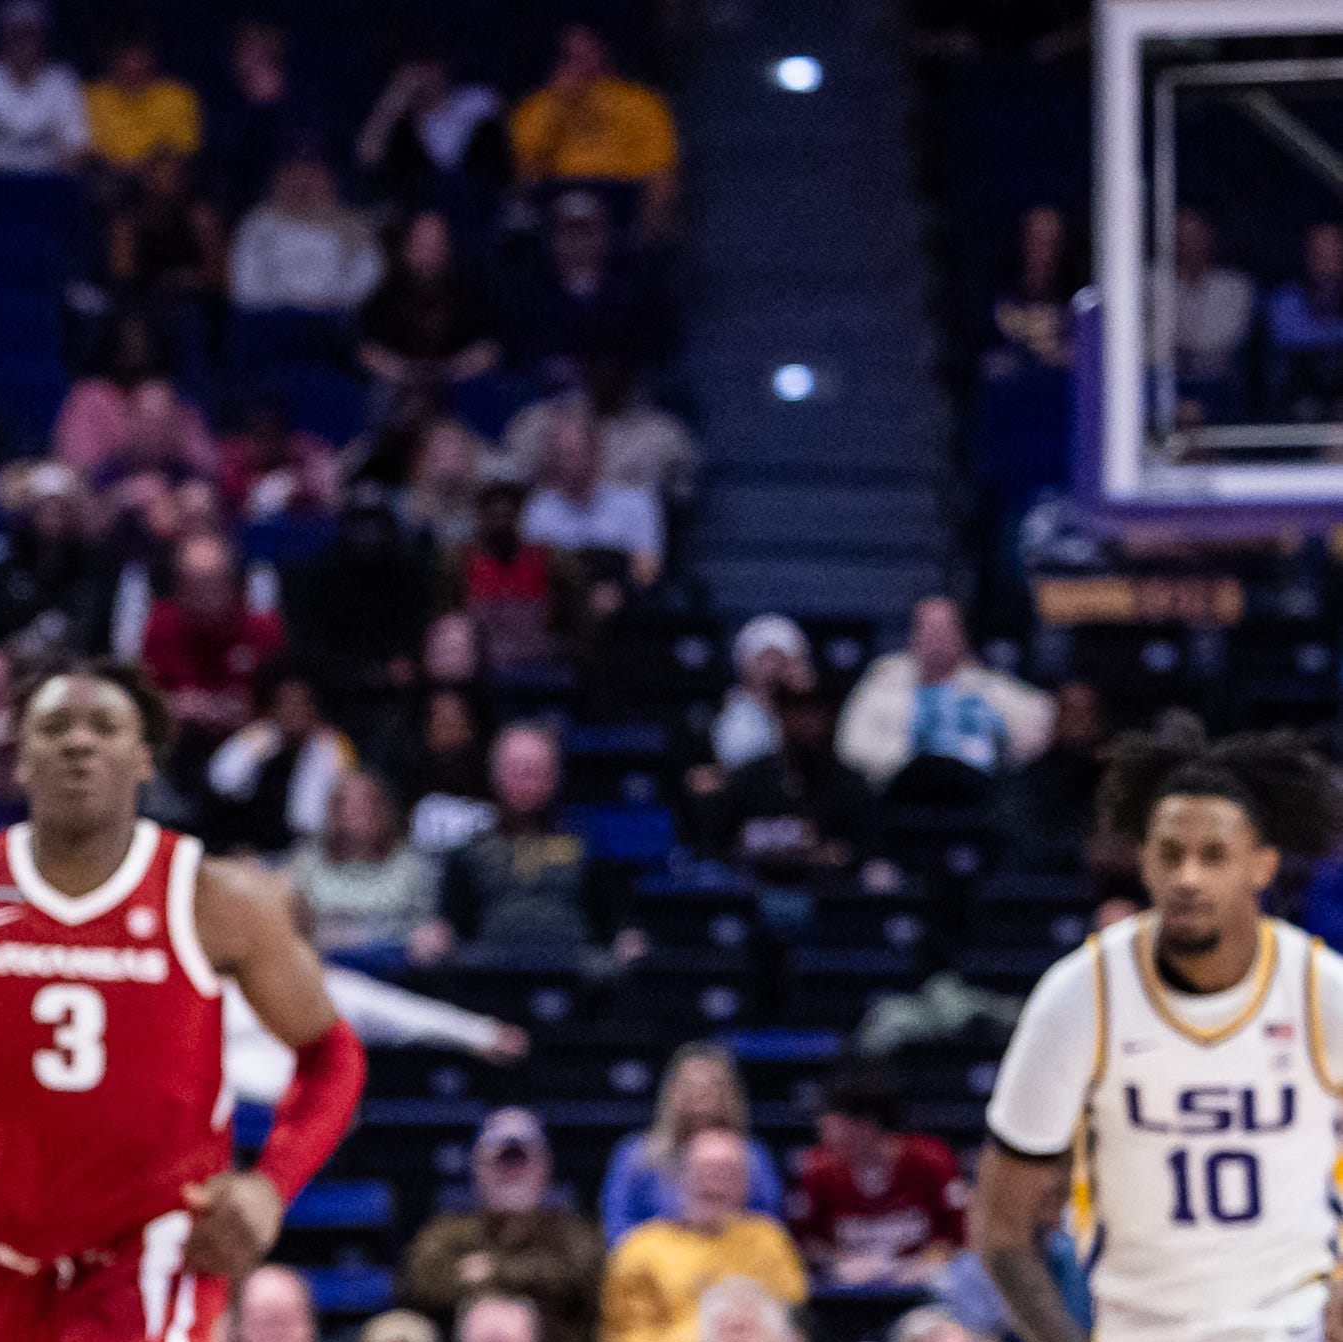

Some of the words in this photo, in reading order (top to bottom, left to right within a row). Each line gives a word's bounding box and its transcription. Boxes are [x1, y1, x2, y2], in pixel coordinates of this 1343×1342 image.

[30, 982, 107, 1092] 3
[1123, 1081, 1295, 1134] LSU
[1167, 1147, 1262, 1225] 10
